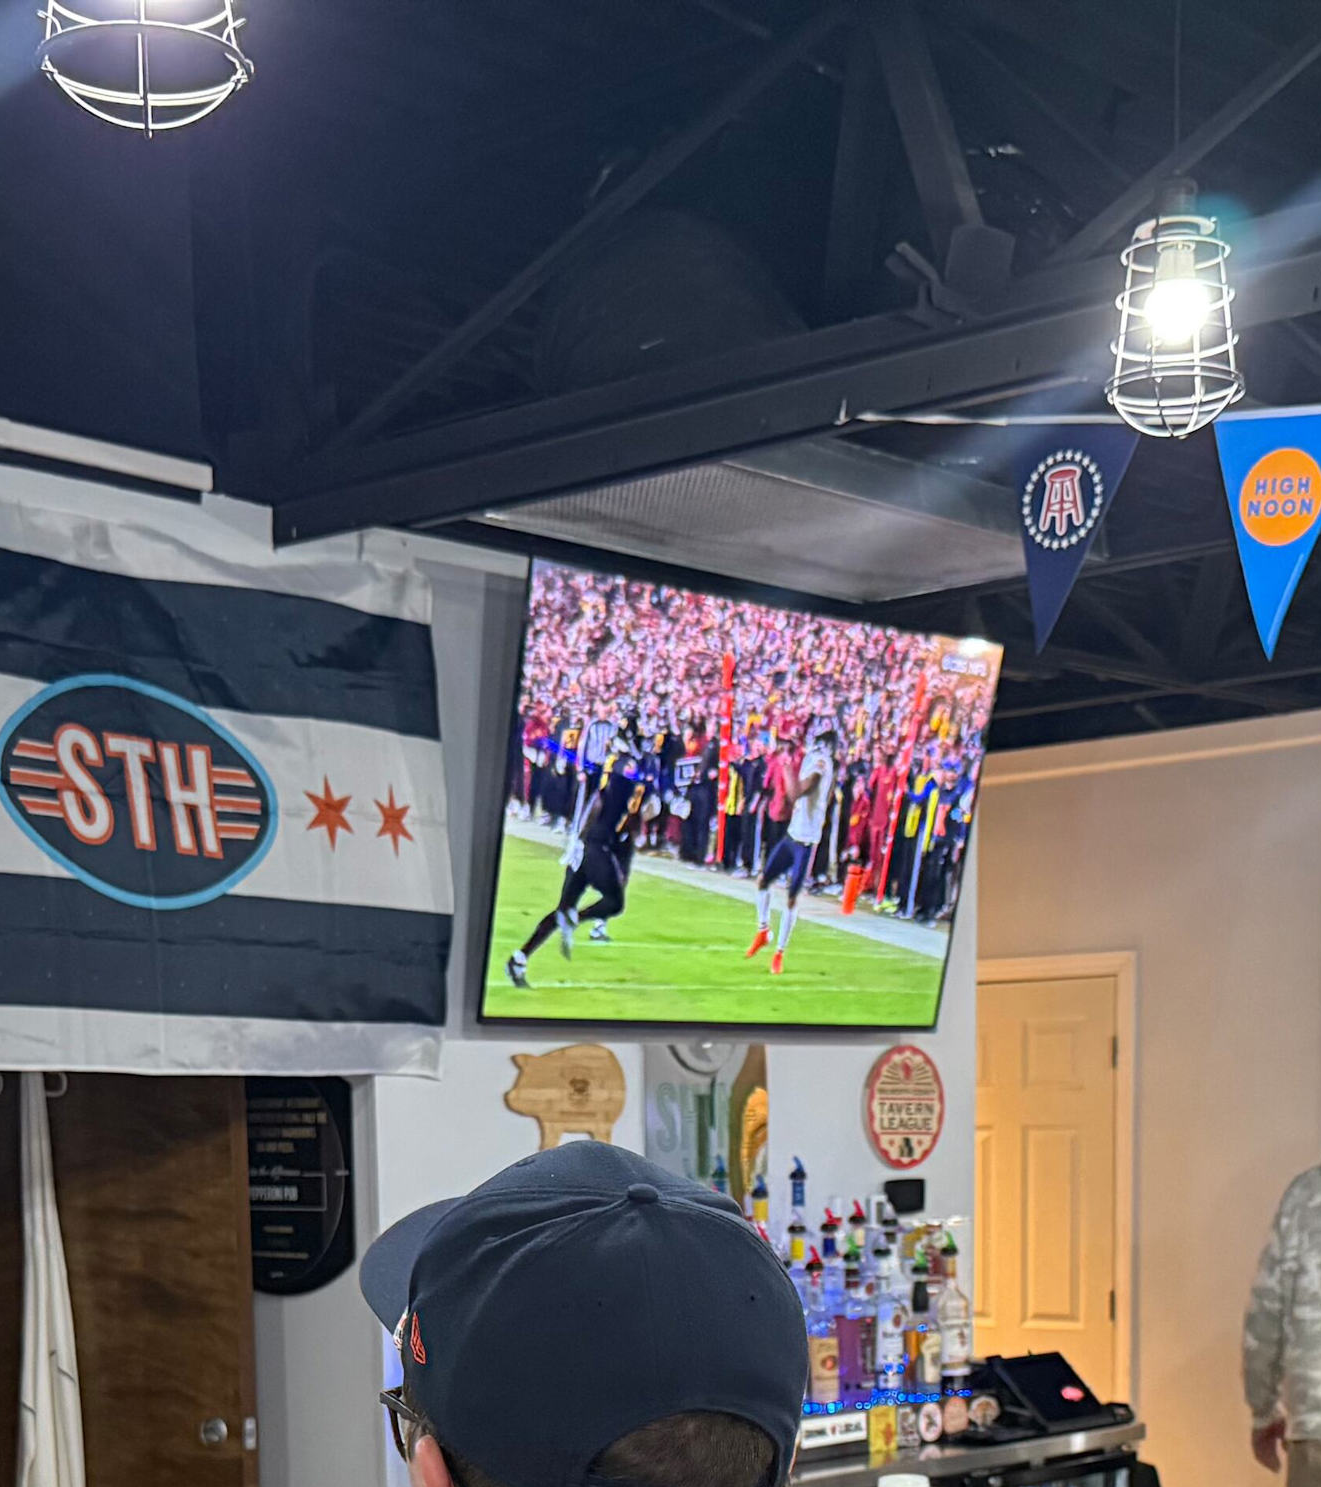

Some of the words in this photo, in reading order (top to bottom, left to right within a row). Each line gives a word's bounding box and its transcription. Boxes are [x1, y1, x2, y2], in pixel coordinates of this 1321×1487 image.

[1255, 476, 1311, 496] HIGH
[1247, 498, 1315, 517] NOON
[52, 721, 224, 860] STH
[878, 1102, 935, 1116] TAVERN
[879, 1116, 934, 1131] LEAGUE
